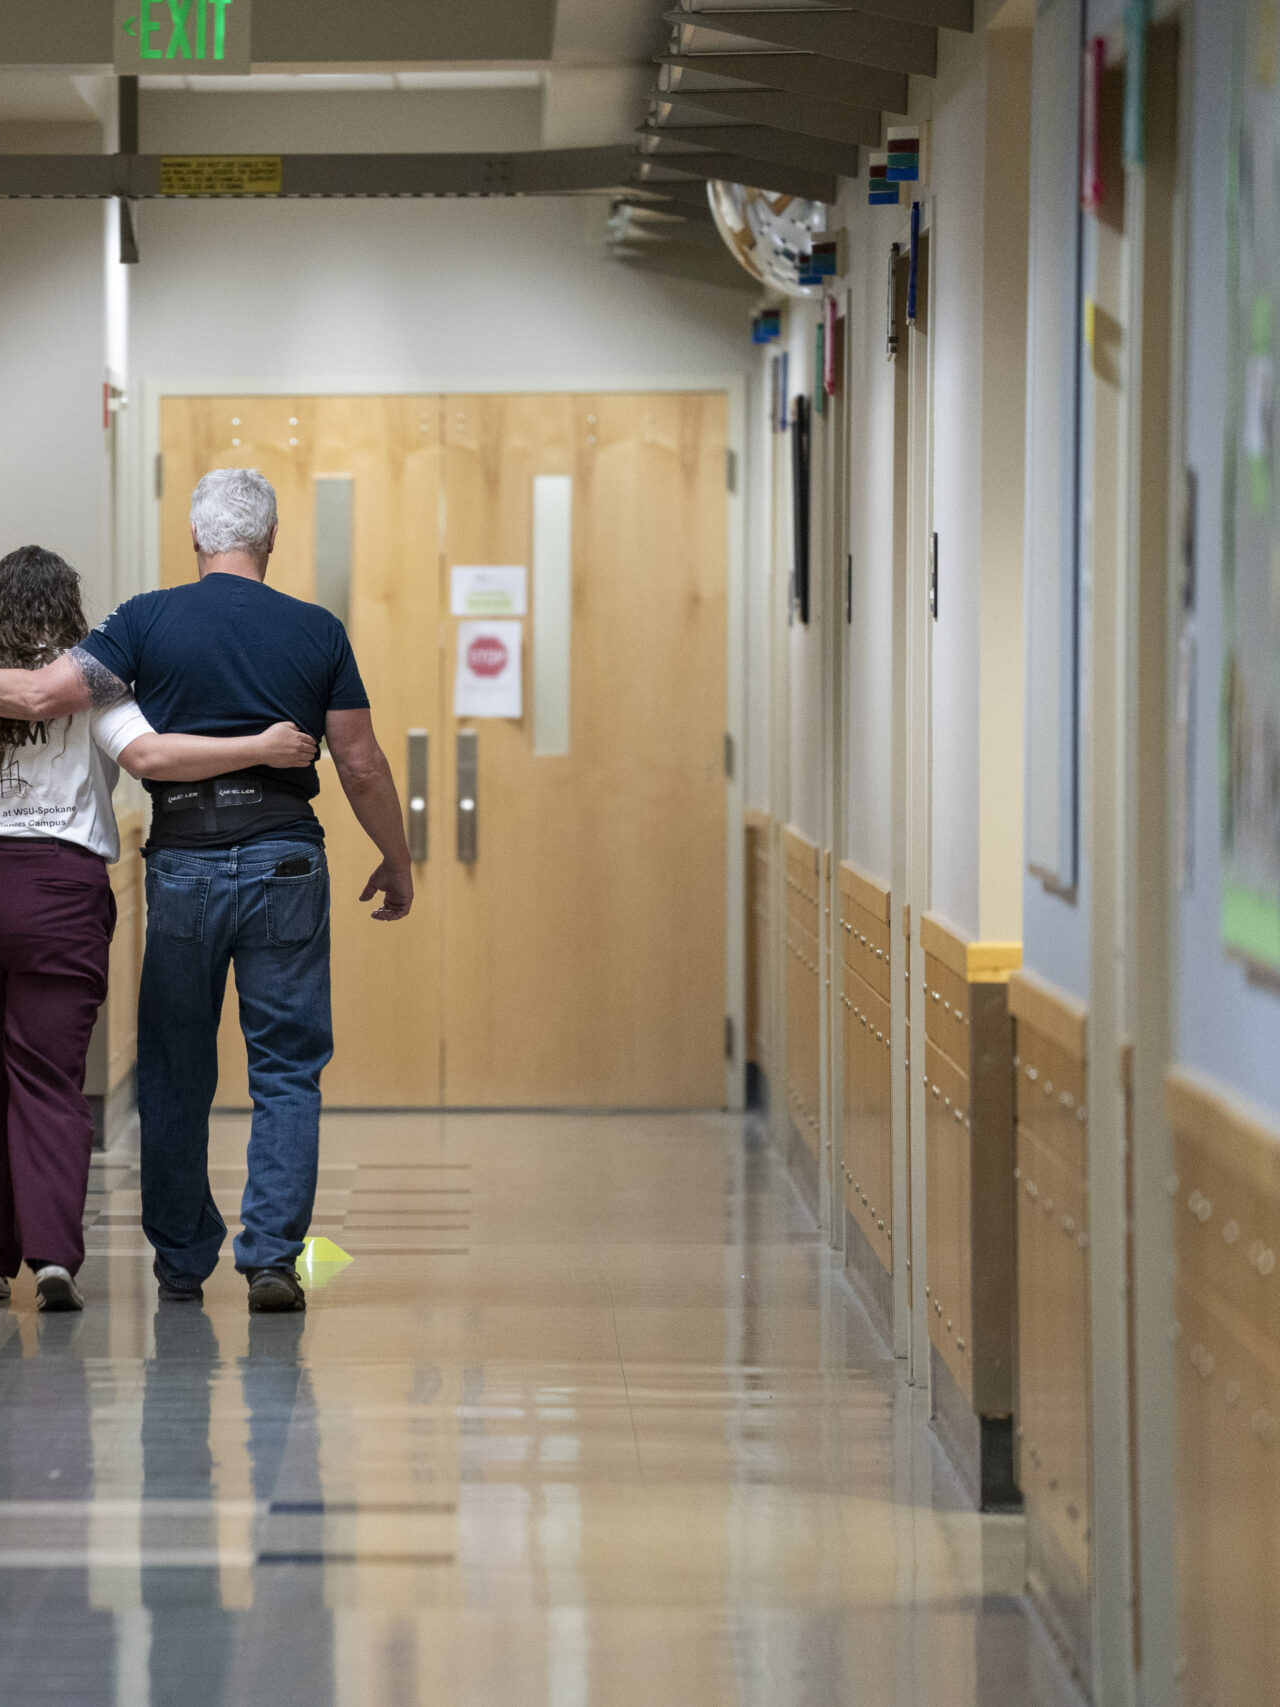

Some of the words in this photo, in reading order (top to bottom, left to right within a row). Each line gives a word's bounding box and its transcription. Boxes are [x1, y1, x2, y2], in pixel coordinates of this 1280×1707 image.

[139, 0, 232, 60] EXIT
[12, 805, 77, 816] WSU-Spokane
[28, 819, 67, 828] Campus
